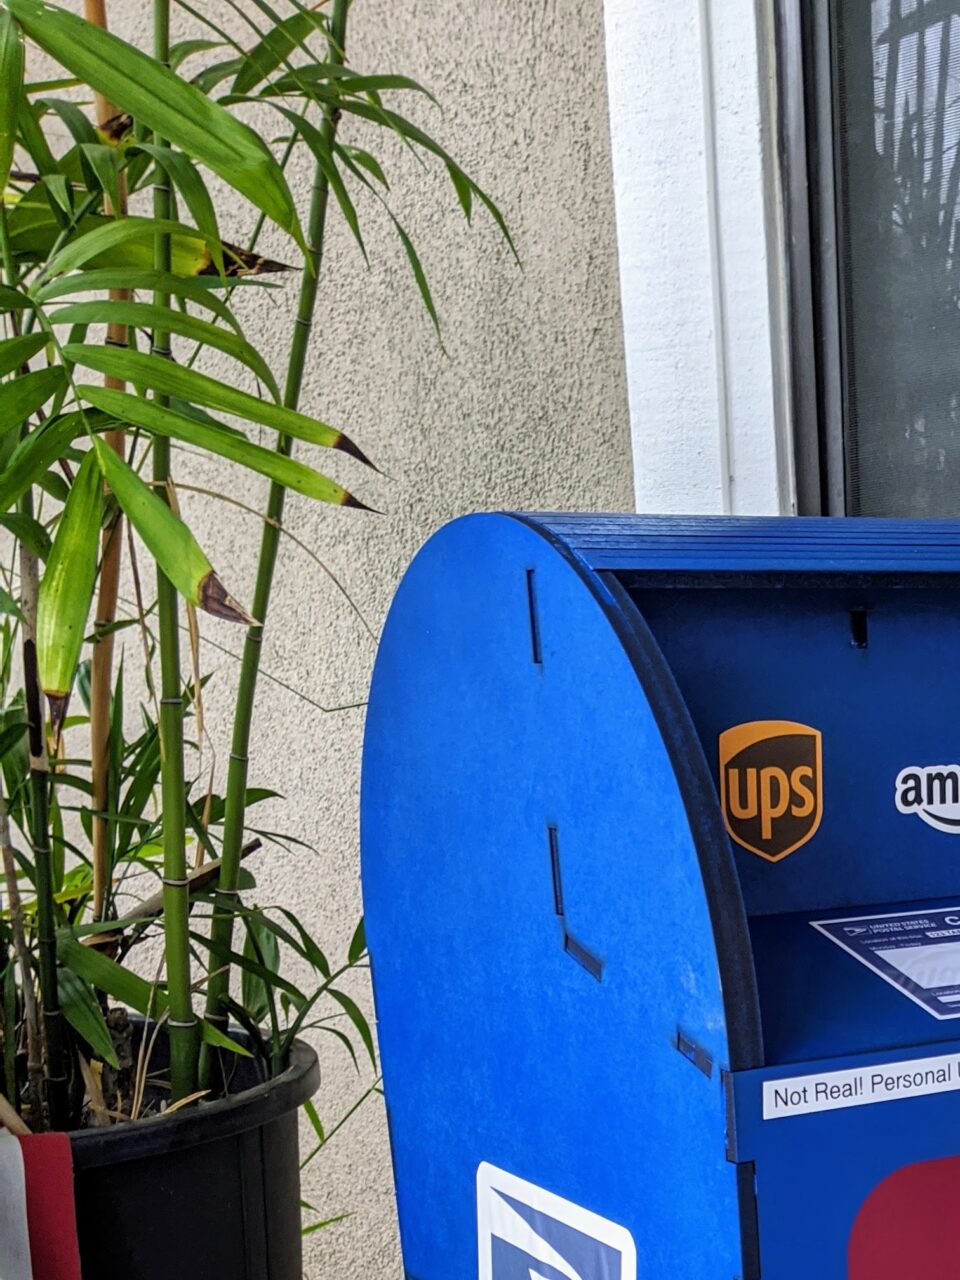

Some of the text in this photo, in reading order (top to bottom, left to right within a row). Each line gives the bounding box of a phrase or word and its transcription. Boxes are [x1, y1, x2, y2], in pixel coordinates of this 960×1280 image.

[728, 766, 815, 840] ups
[773, 1085, 809, 1109] Not
[814, 1075, 866, 1102] Real!
[870, 1062, 952, 1095] Personal
